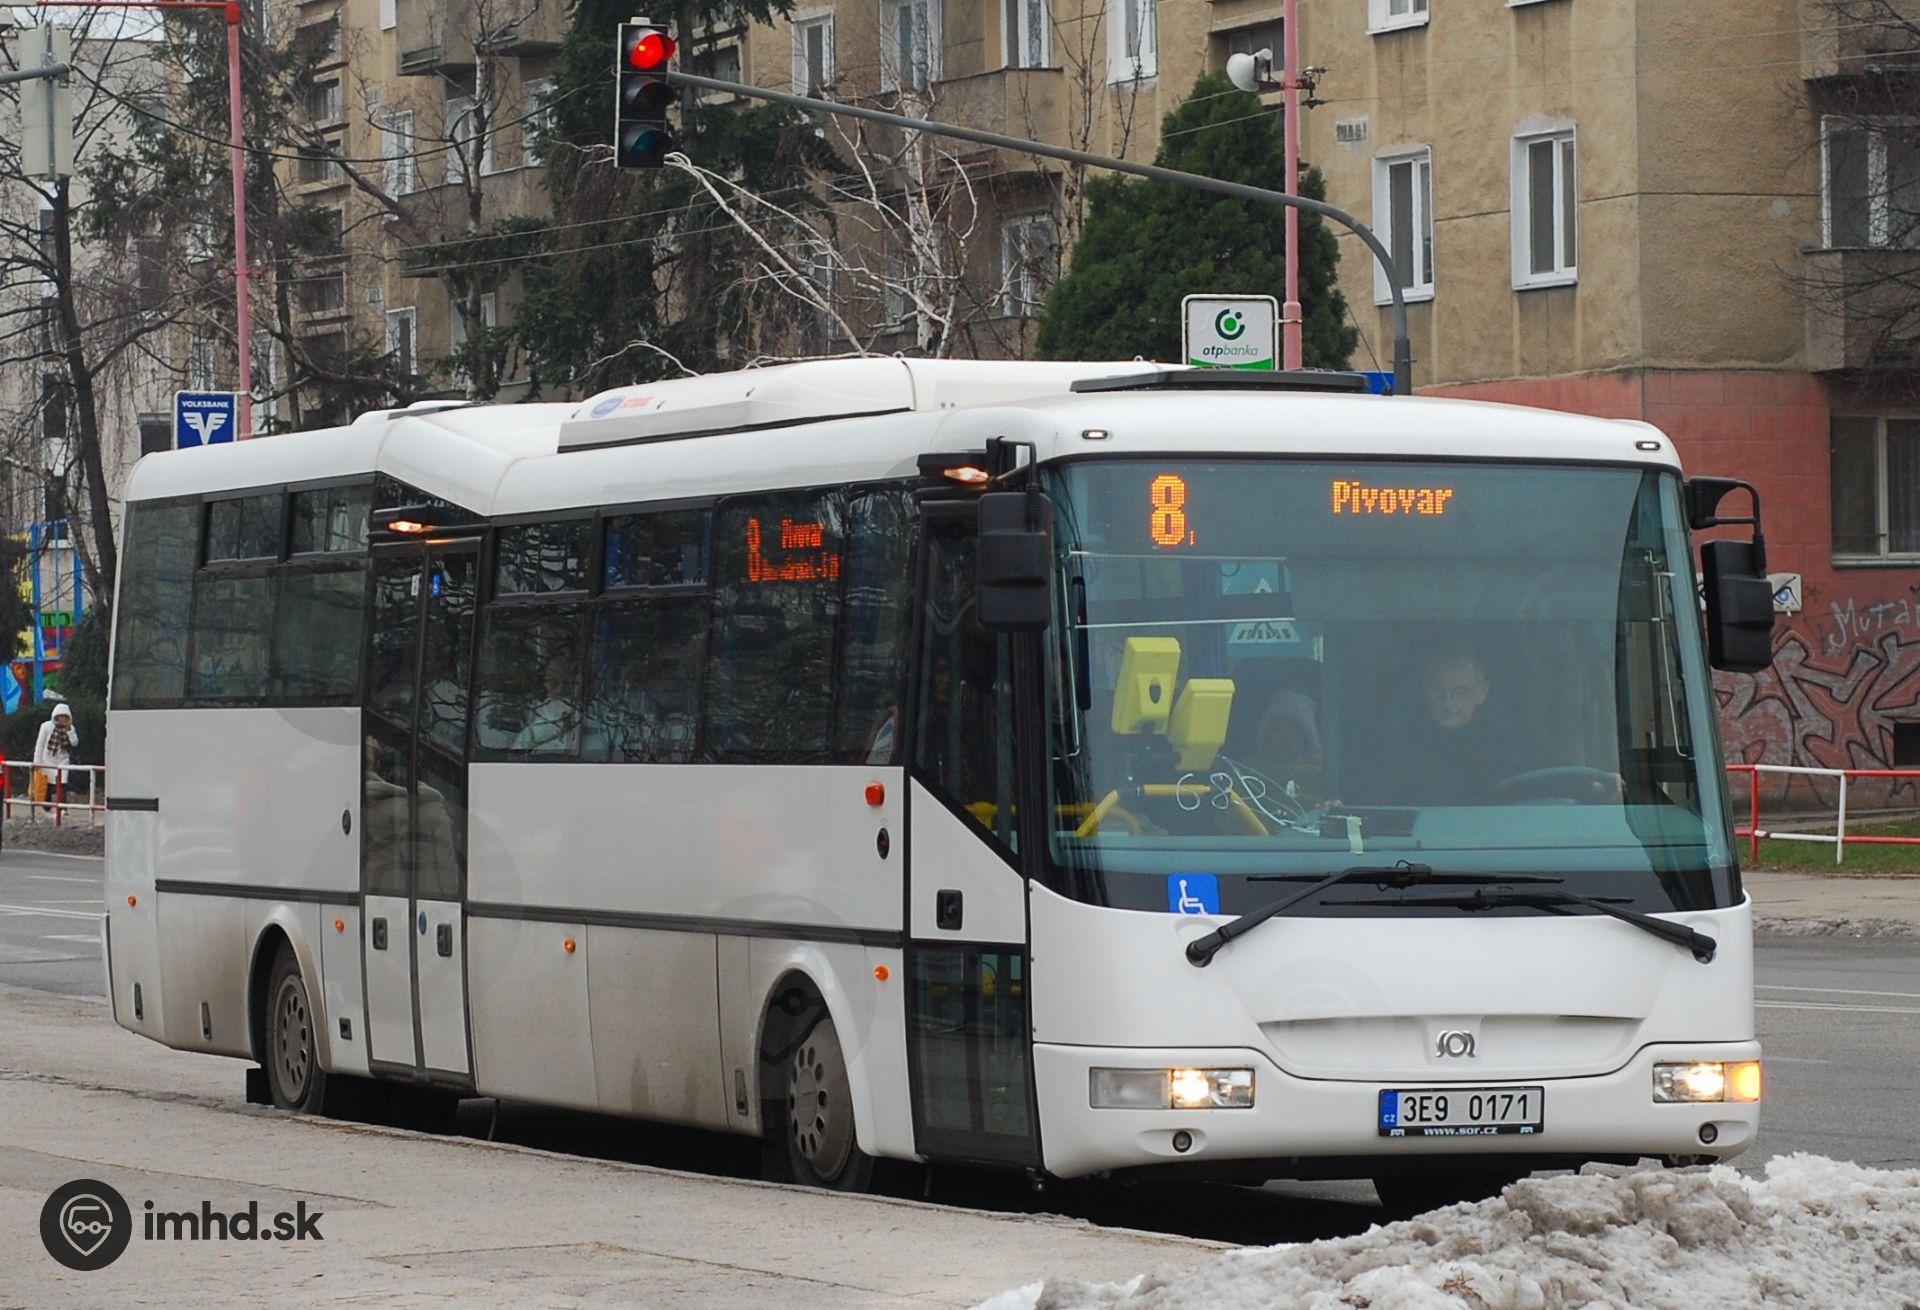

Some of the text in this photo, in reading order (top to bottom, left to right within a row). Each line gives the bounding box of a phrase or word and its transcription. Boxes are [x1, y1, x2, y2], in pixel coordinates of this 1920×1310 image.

[1202, 345, 1258, 358] otpbanka
[181, 400, 229, 409] VOLKSBANK
[1332, 481, 1452, 513] Pivovar
[1151, 475, 1185, 545] 8
[1403, 1094, 1528, 1122] 3E9 0171
[1383, 1114, 1395, 1122] CZ
[1423, 1127, 1498, 1135] www.sor.cz
